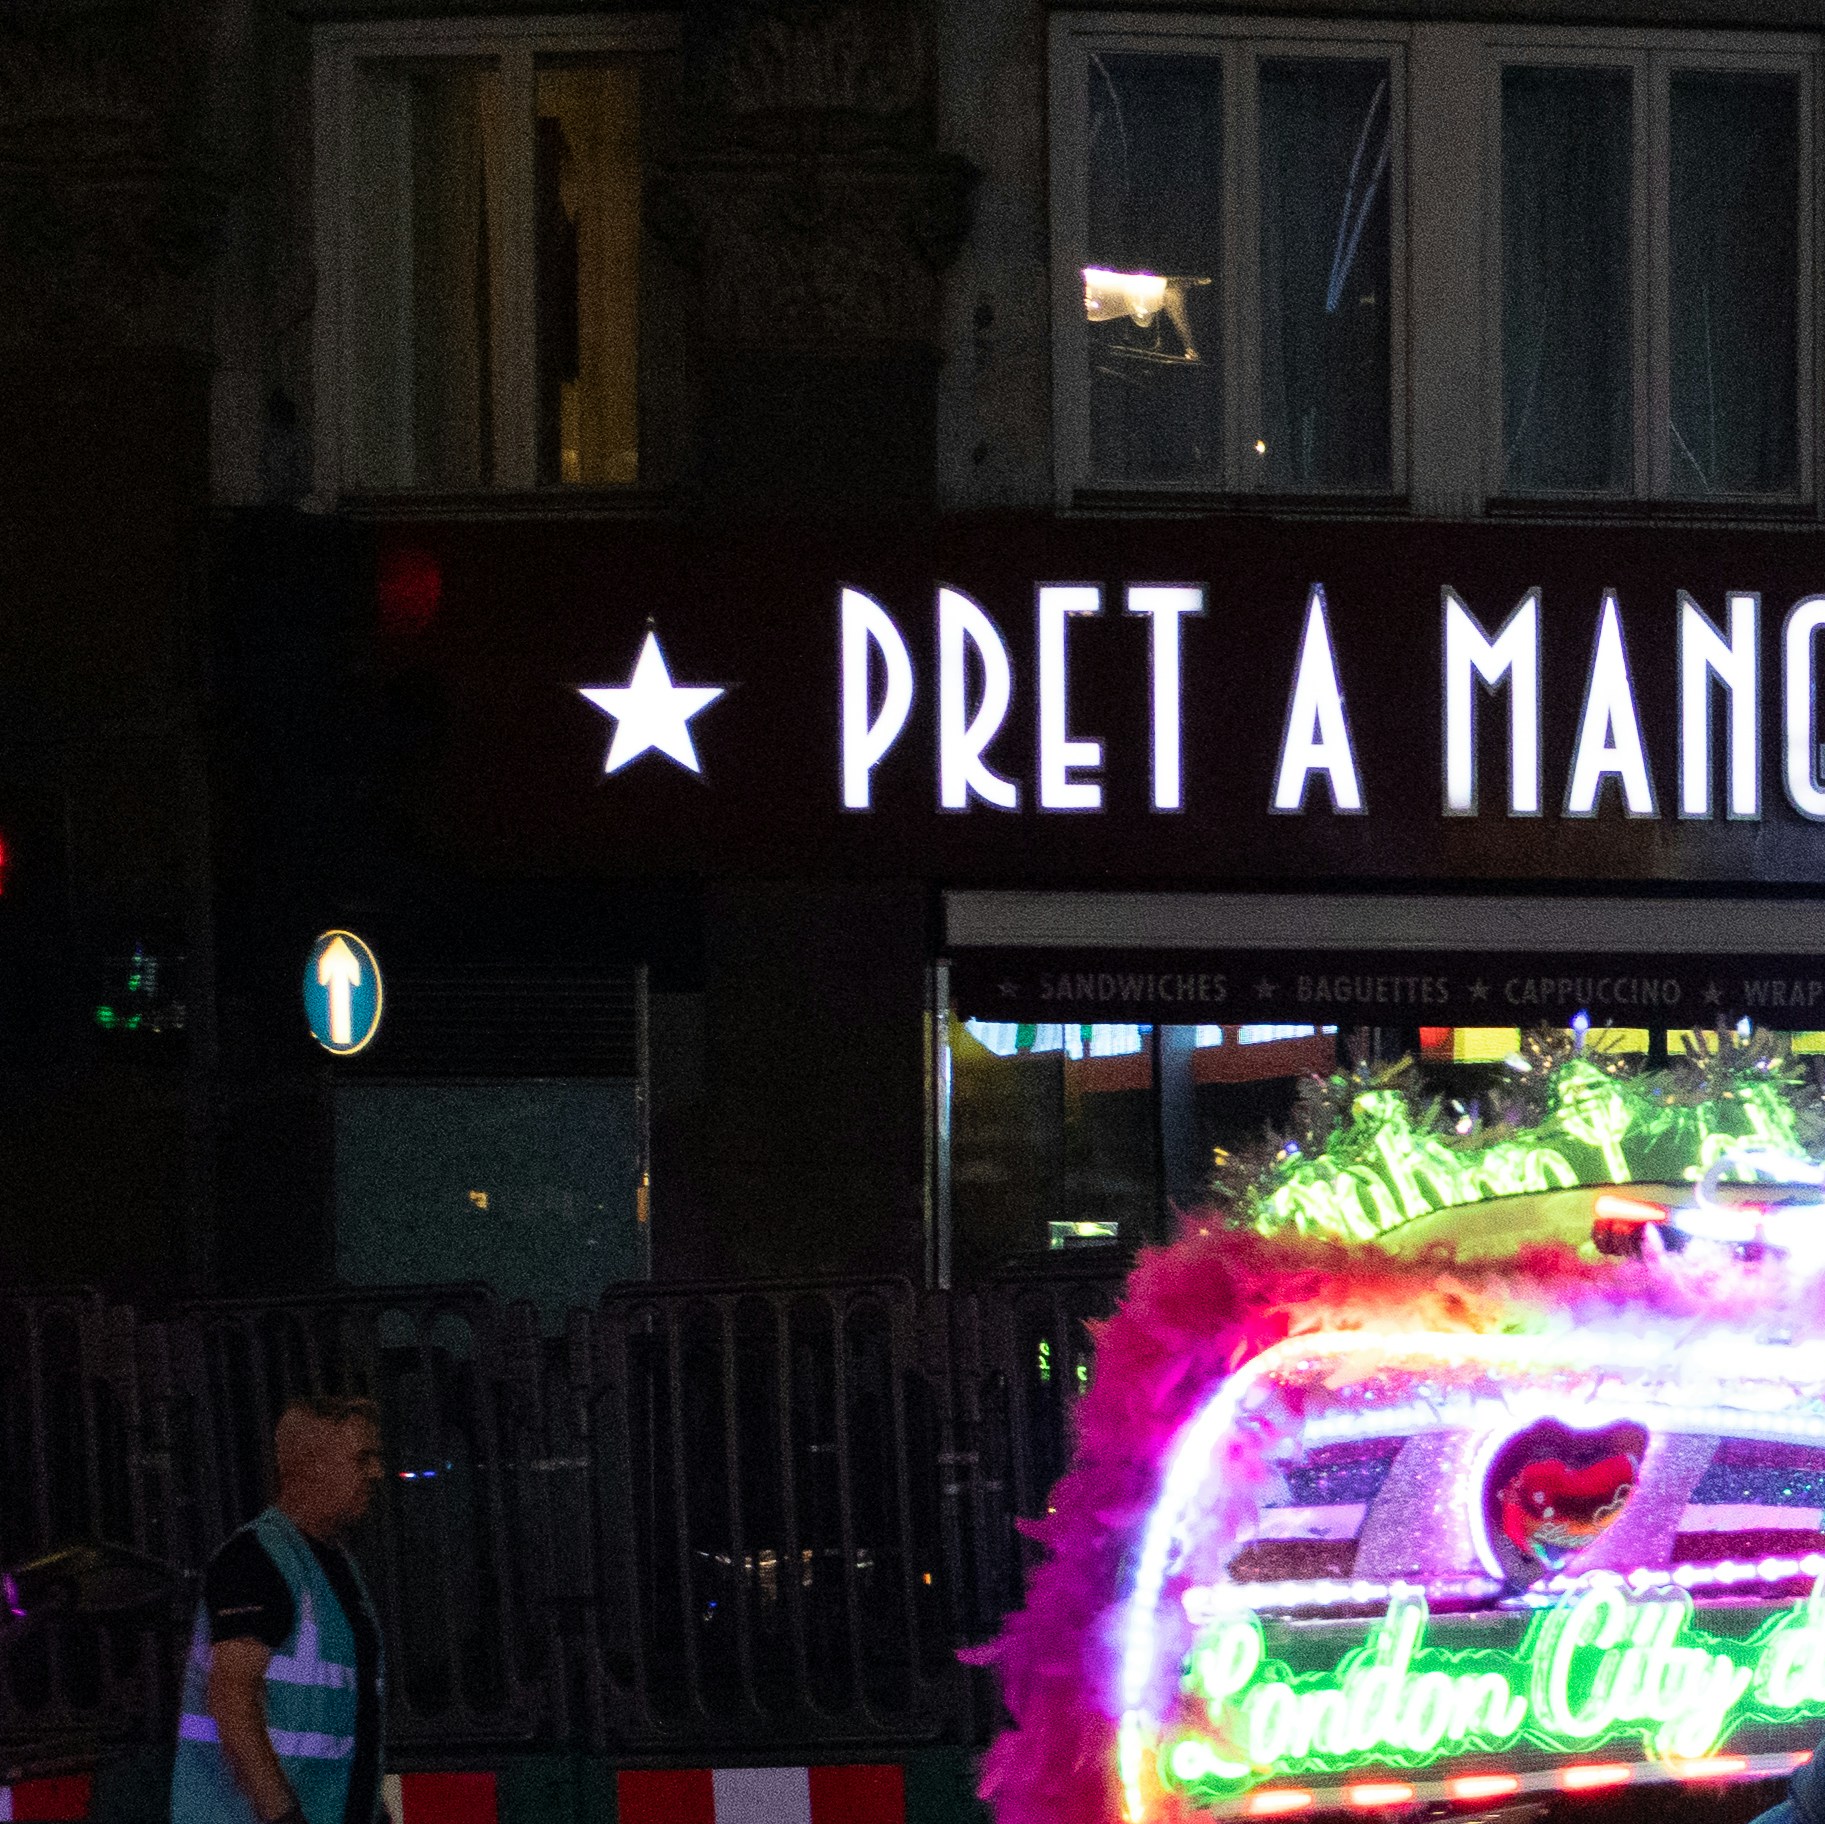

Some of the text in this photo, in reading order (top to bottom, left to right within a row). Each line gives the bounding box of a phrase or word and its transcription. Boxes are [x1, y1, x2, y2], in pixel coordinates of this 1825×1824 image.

[836, 579, 1209, 814] PRET
[1266, 580, 1370, 816] A
[1038, 973, 1229, 1003] SANDWICHES
[1295, 974, 1450, 1005] BAGUETTES
[1504, 976, 1683, 1007] CAPPUCCINO
[1172, 1598, 1529, 1781] London
[1546, 1588, 1754, 1758] City
